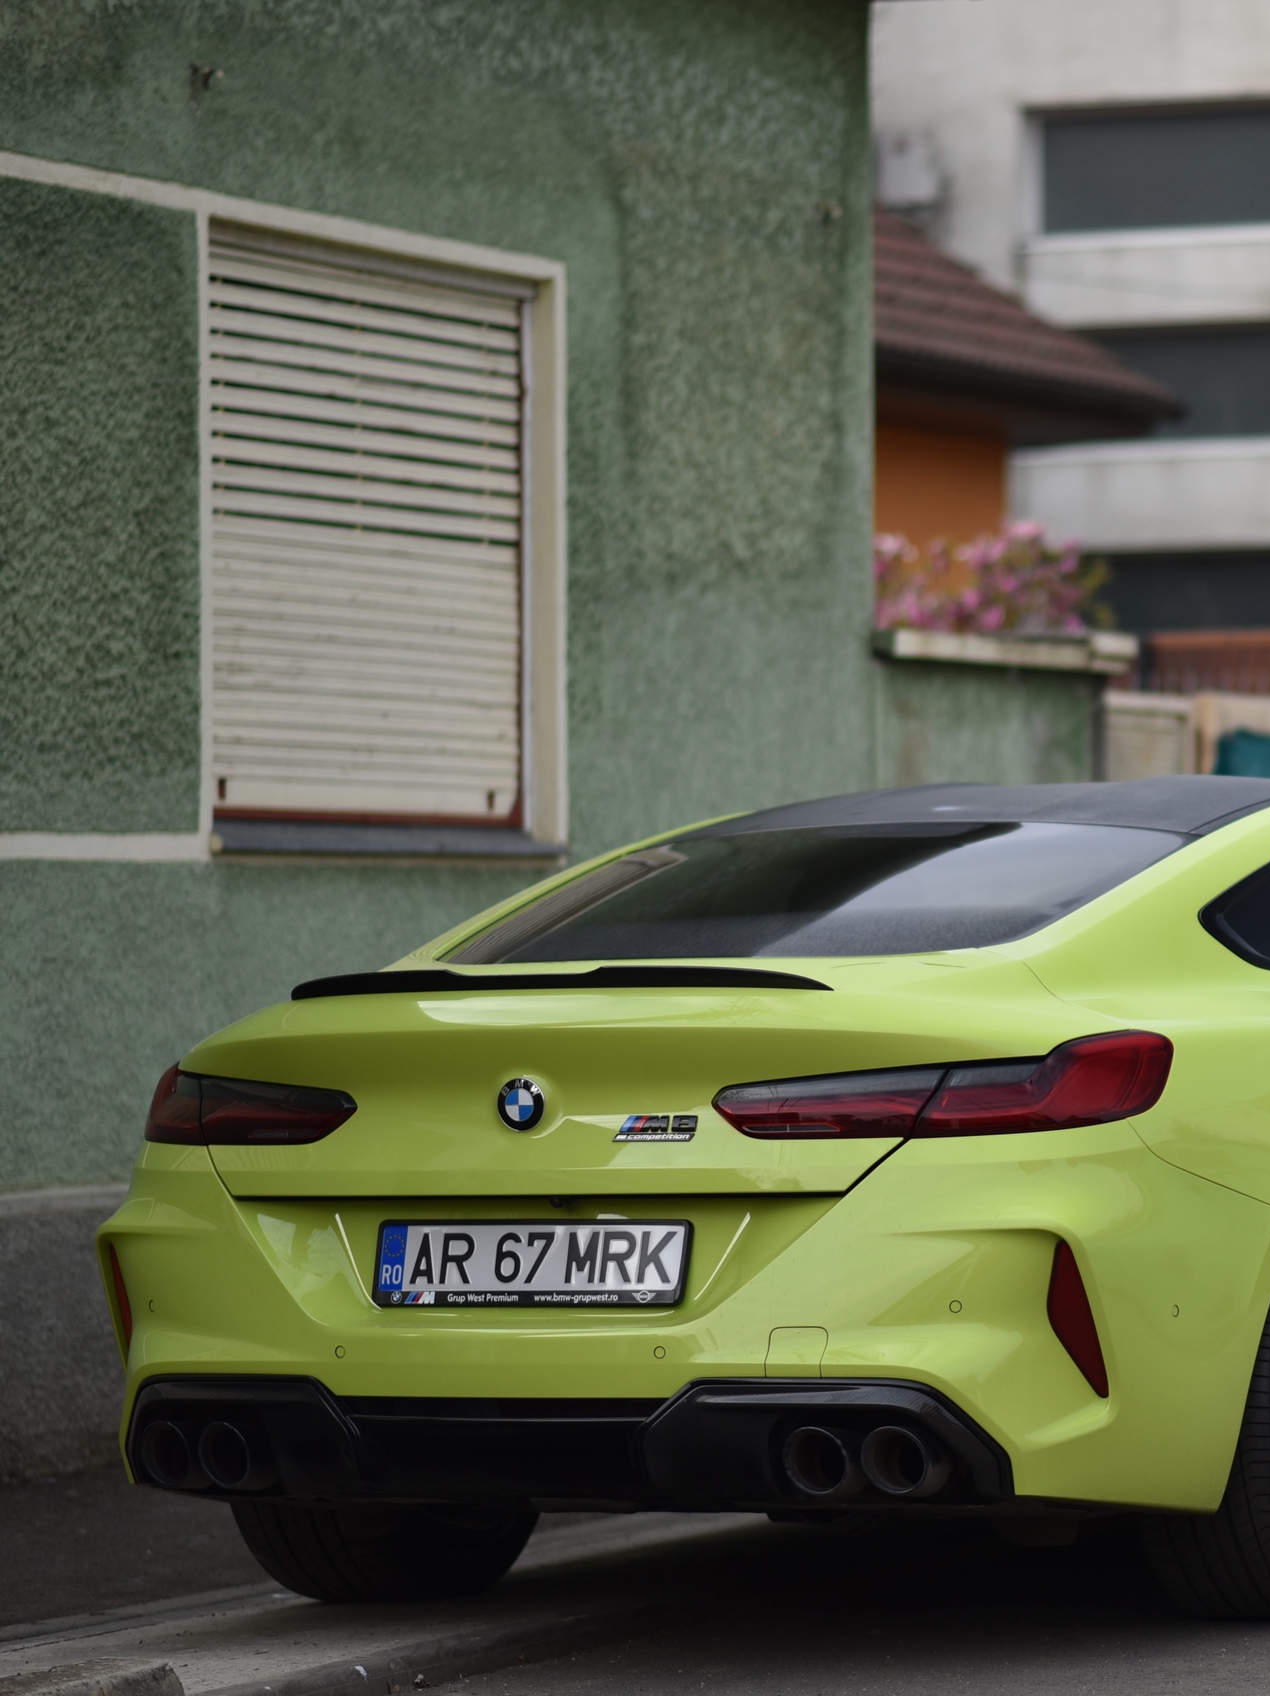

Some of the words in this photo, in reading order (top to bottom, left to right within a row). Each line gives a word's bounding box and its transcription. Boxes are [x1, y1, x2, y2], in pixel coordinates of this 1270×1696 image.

[501, 1079, 541, 1096] BMW
[639, 1115, 698, 1132] M8
[409, 1232, 476, 1284] AR
[494, 1232, 556, 1283] 67
[564, 1231, 678, 1284] MRK
[381, 1264, 402, 1285] RO
[447, 1293, 466, 1304] Grup
[467, 1293, 485, 1302] West
[486, 1293, 519, 1303] Premium
[533, 1292, 619, 1304] www.bmw-grupwest.ro
